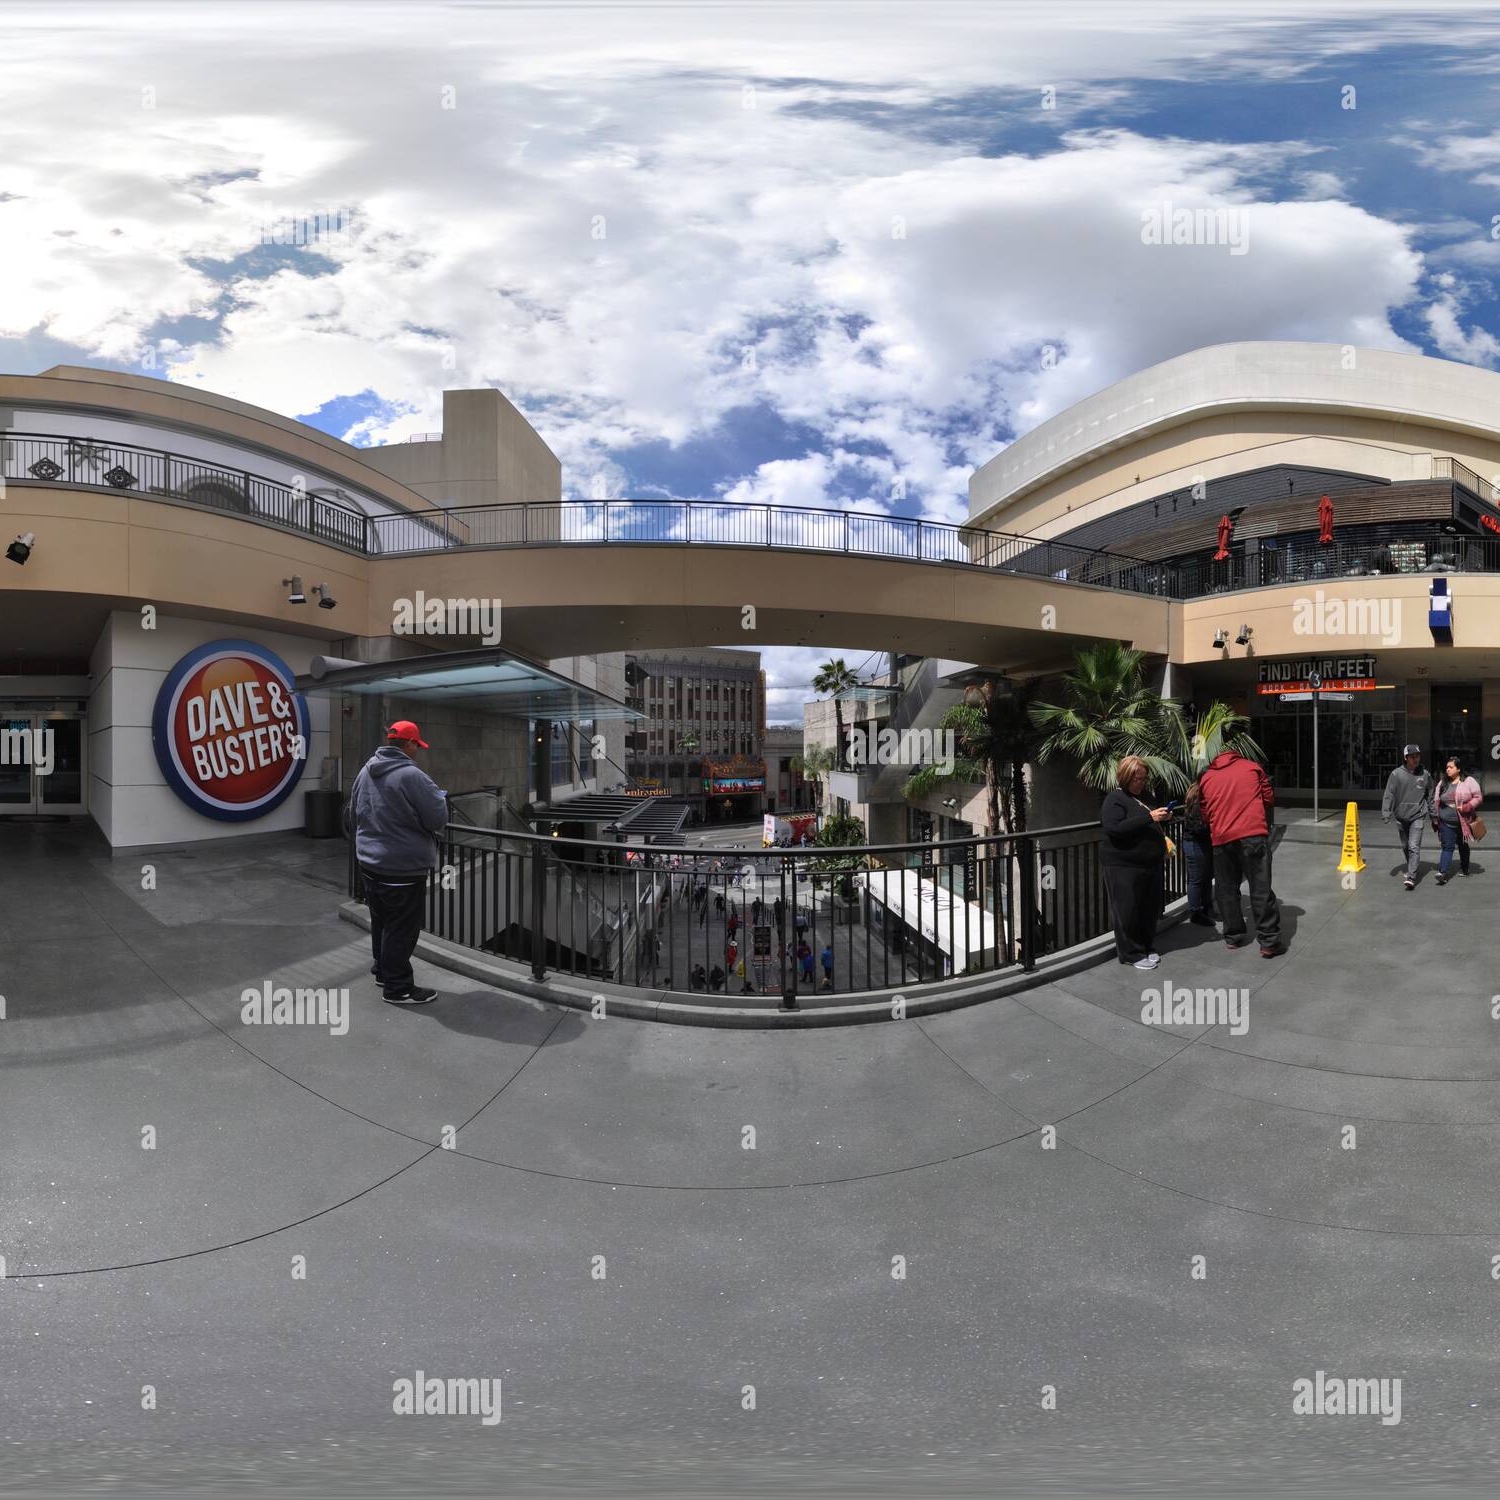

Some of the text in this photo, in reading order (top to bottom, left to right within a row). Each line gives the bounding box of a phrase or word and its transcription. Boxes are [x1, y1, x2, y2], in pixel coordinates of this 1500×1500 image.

[1259, 658, 1376, 682] FIND YOUR FEET
[1313, 673, 1321, 687] 3
[187, 681, 291, 743] DAVE &
[192, 721, 294, 782] BUSTER'S
